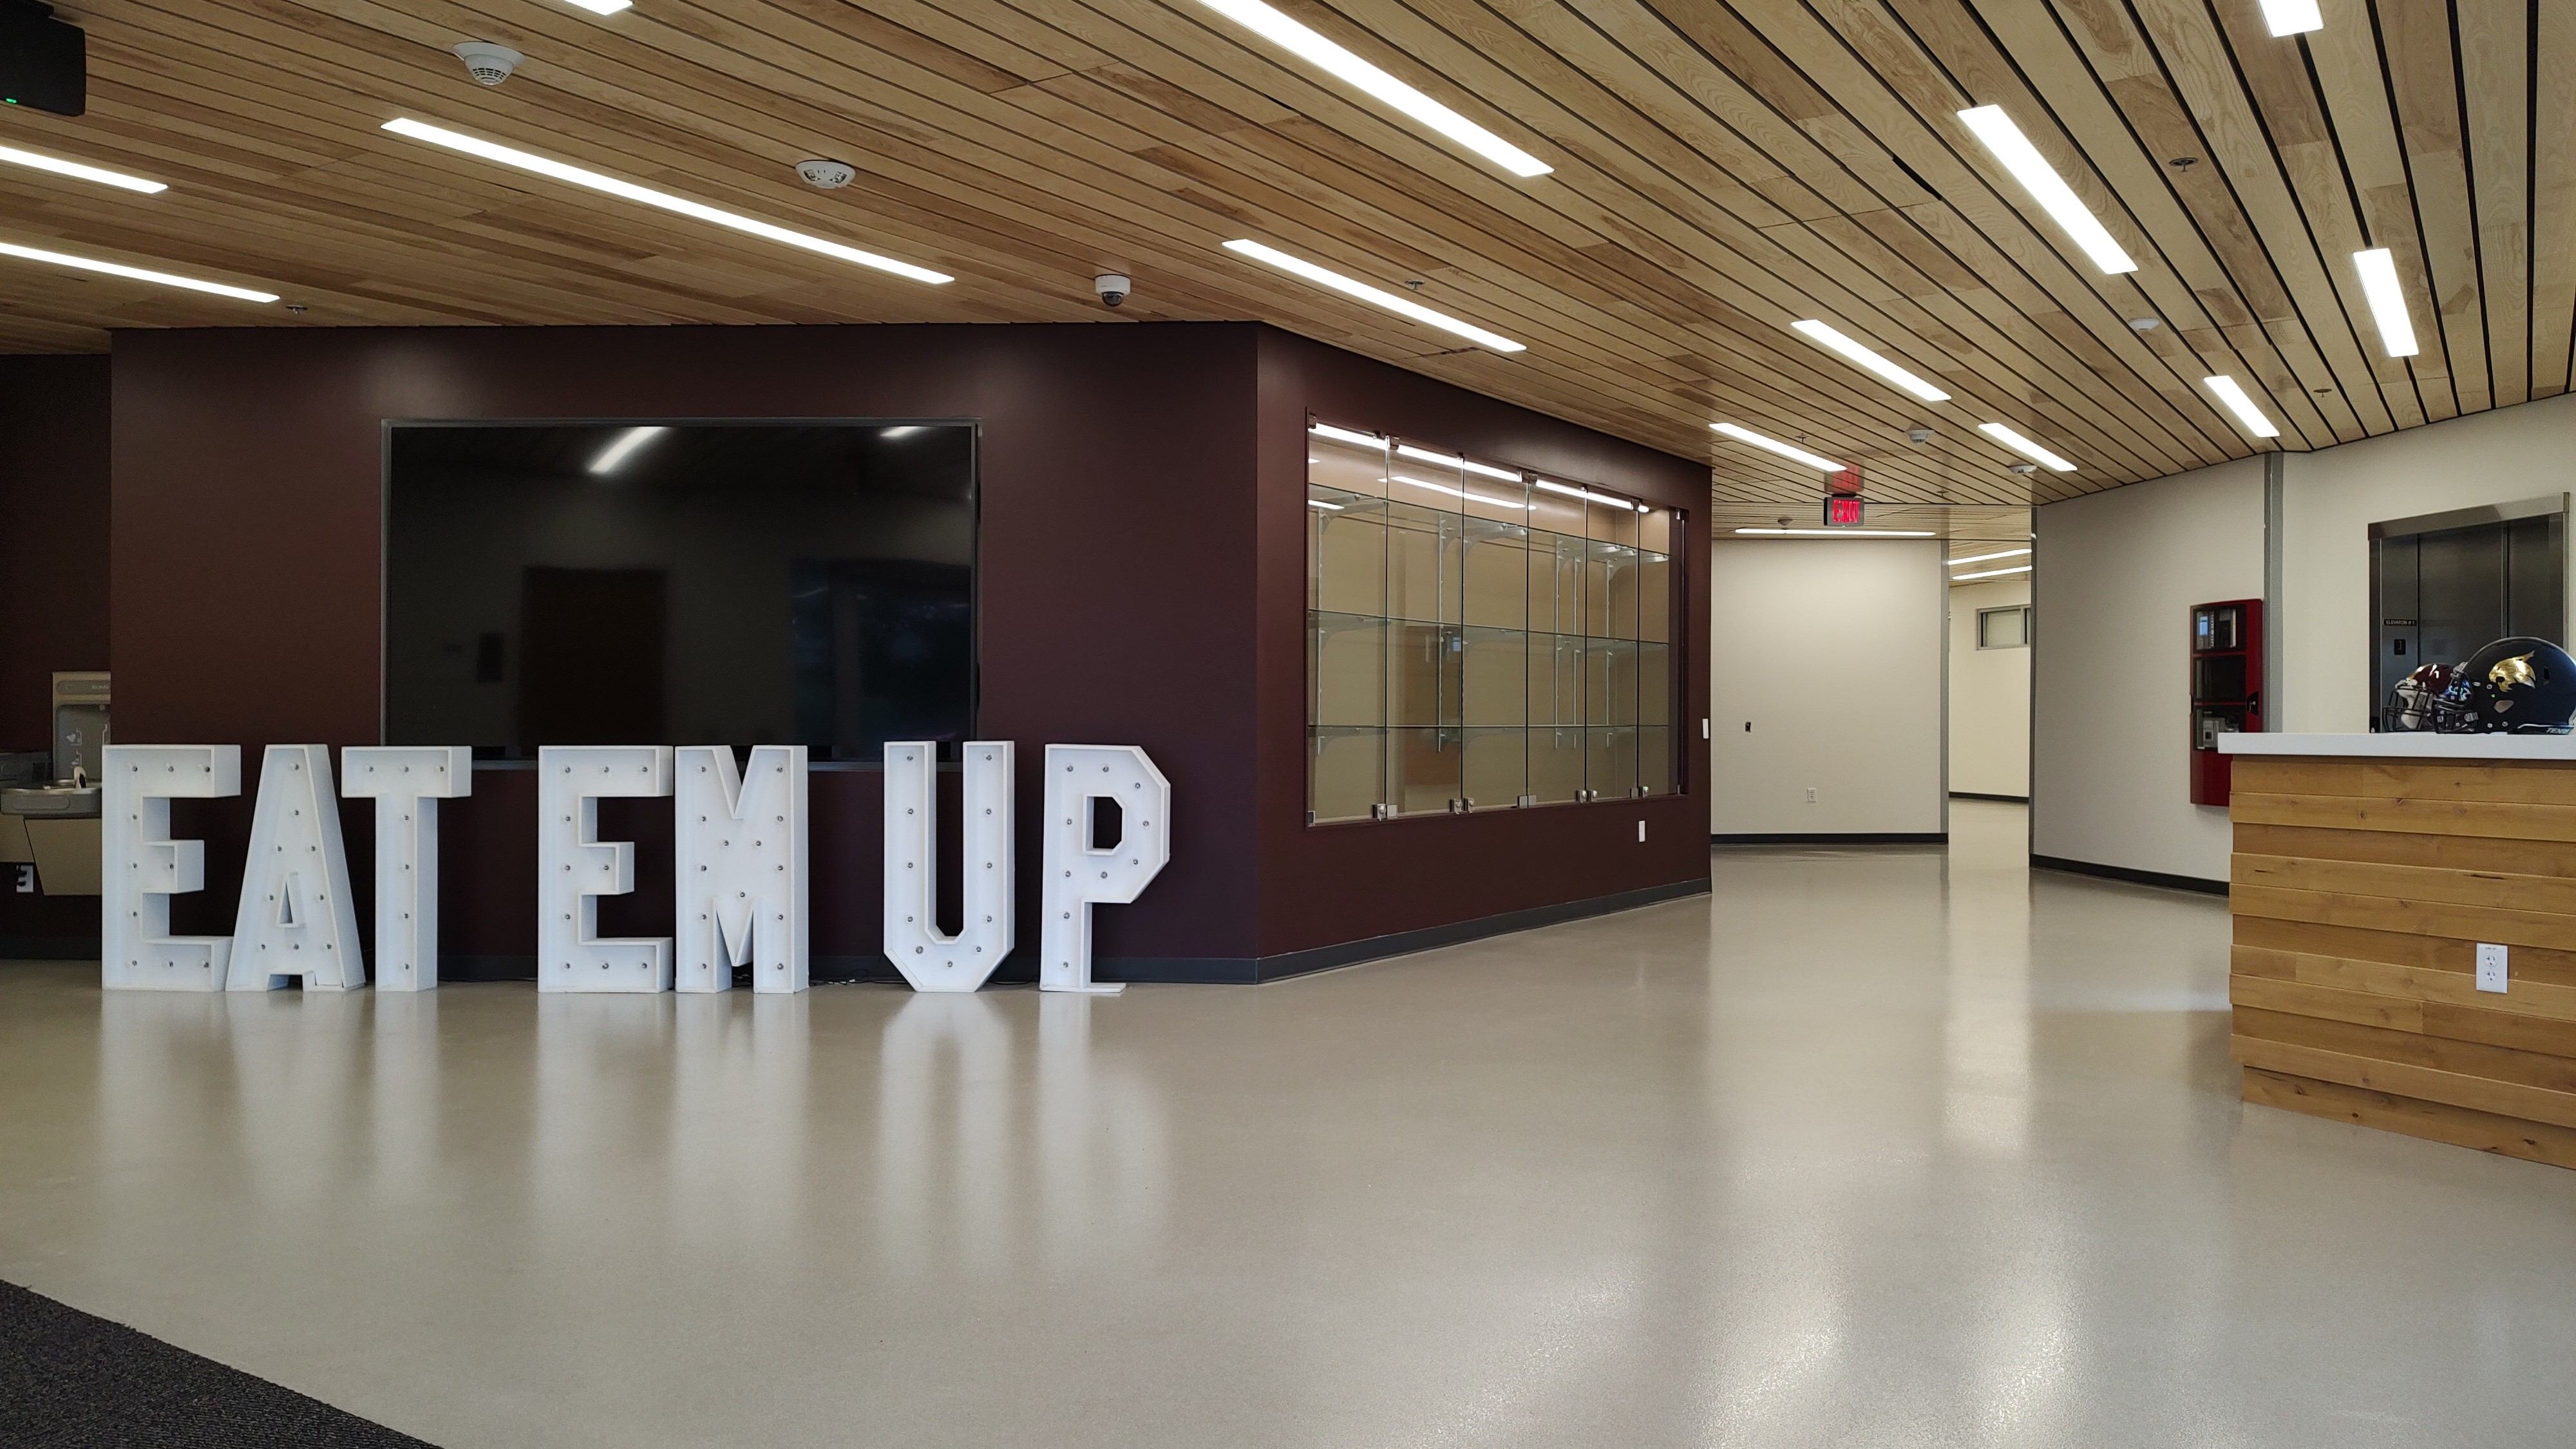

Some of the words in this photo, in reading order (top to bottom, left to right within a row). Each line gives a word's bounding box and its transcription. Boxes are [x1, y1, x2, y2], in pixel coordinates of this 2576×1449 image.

[1833, 499, 1860, 523] EXIT
[102, 744, 471, 992] EAT
[538, 744, 809, 993] EM
[884, 741, 1170, 993] UP
